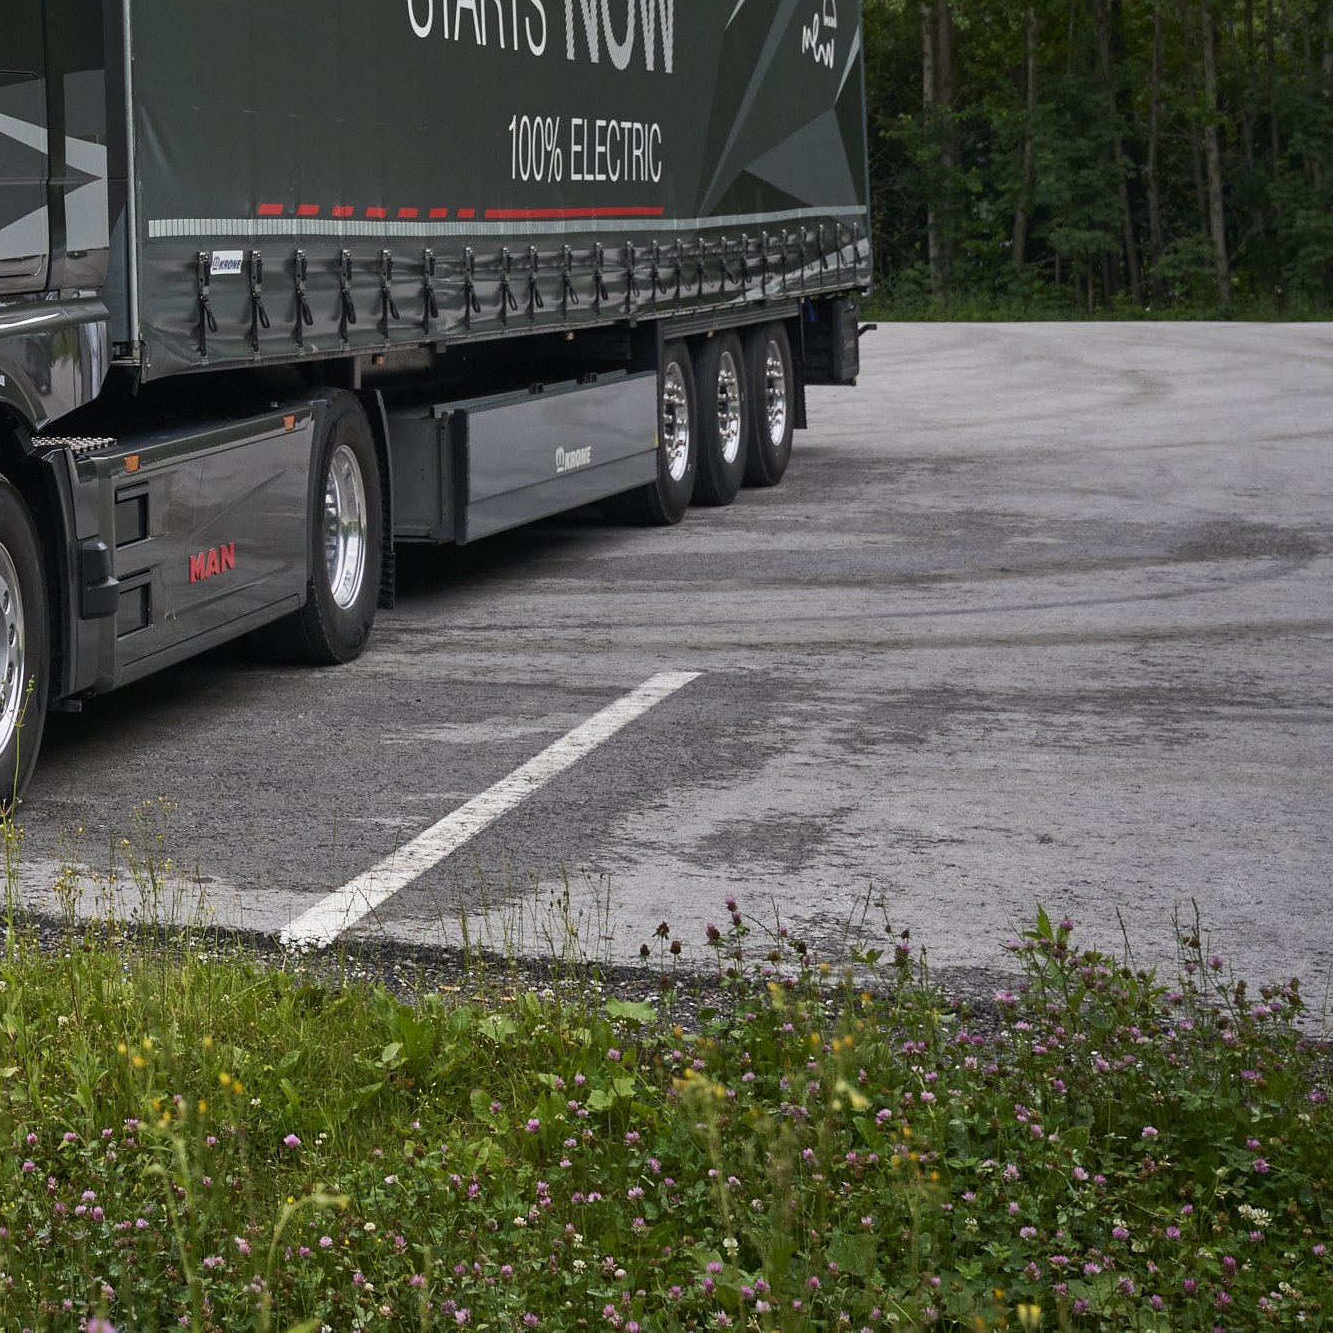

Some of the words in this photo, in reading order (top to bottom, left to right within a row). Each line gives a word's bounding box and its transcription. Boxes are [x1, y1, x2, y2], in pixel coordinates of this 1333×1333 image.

[508, 114, 563, 183] 100%
[570, 117, 662, 182] ELECTRIC
[564, 446, 591, 471] KRONE
[189, 541, 235, 583] MAN
